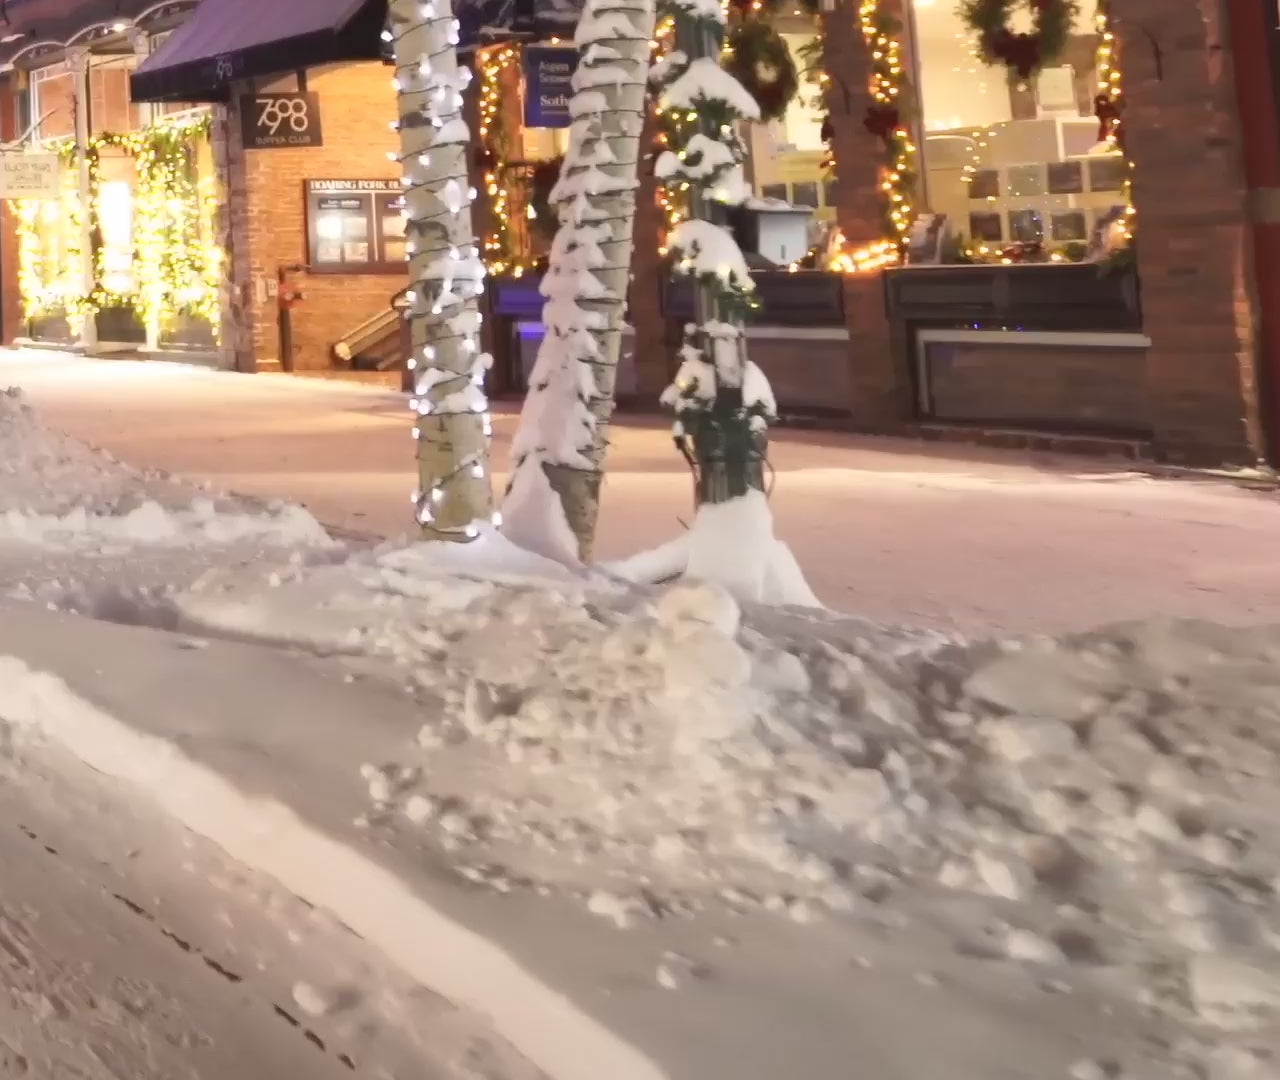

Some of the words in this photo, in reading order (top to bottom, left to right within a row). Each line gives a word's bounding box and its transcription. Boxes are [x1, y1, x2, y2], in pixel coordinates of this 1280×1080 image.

[288, 135, 311, 144] CLUB
[311, 180, 356, 190] ROARING
[359, 180, 386, 190] FORK
